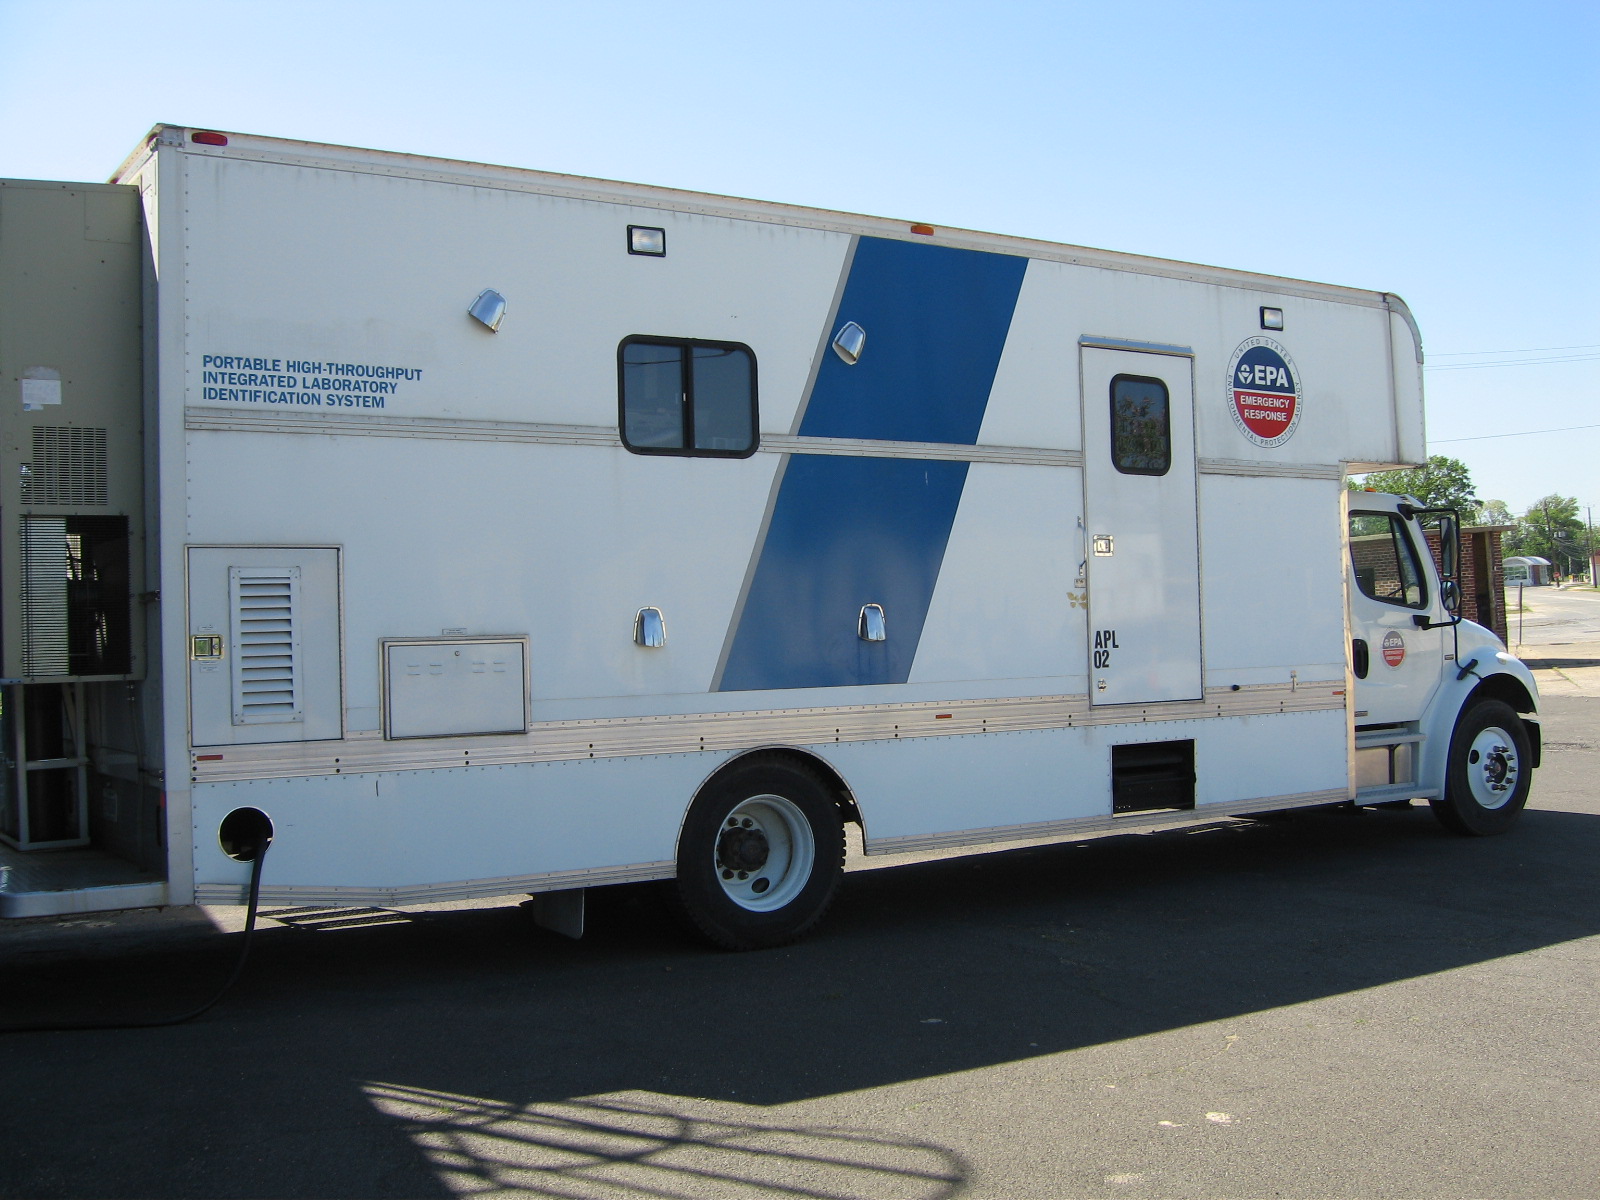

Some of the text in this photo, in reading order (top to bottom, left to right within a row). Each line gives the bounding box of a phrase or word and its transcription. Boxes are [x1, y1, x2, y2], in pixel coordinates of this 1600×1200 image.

[1235, 339, 1292, 365] UNITED STATES
[203, 355, 423, 381] PORTABLE HIGH-THROUGHPUT
[1254, 365, 1289, 387] EPA
[203, 371, 398, 394] INTEGRATED LABORATORY
[203, 387, 385, 408] IDENTIFICATION SYSTEM
[1240, 395, 1290, 408] EMERGENCY
[1228, 375, 1257, 443] ENVIRONMENTAL
[1260, 421, 1297, 446] PROTECTION
[1244, 409, 1287, 421] RESPONSE
[1094, 630, 1119, 649] APL
[1389, 638, 1403, 647] EPA
[1093, 650, 1110, 669] 02
